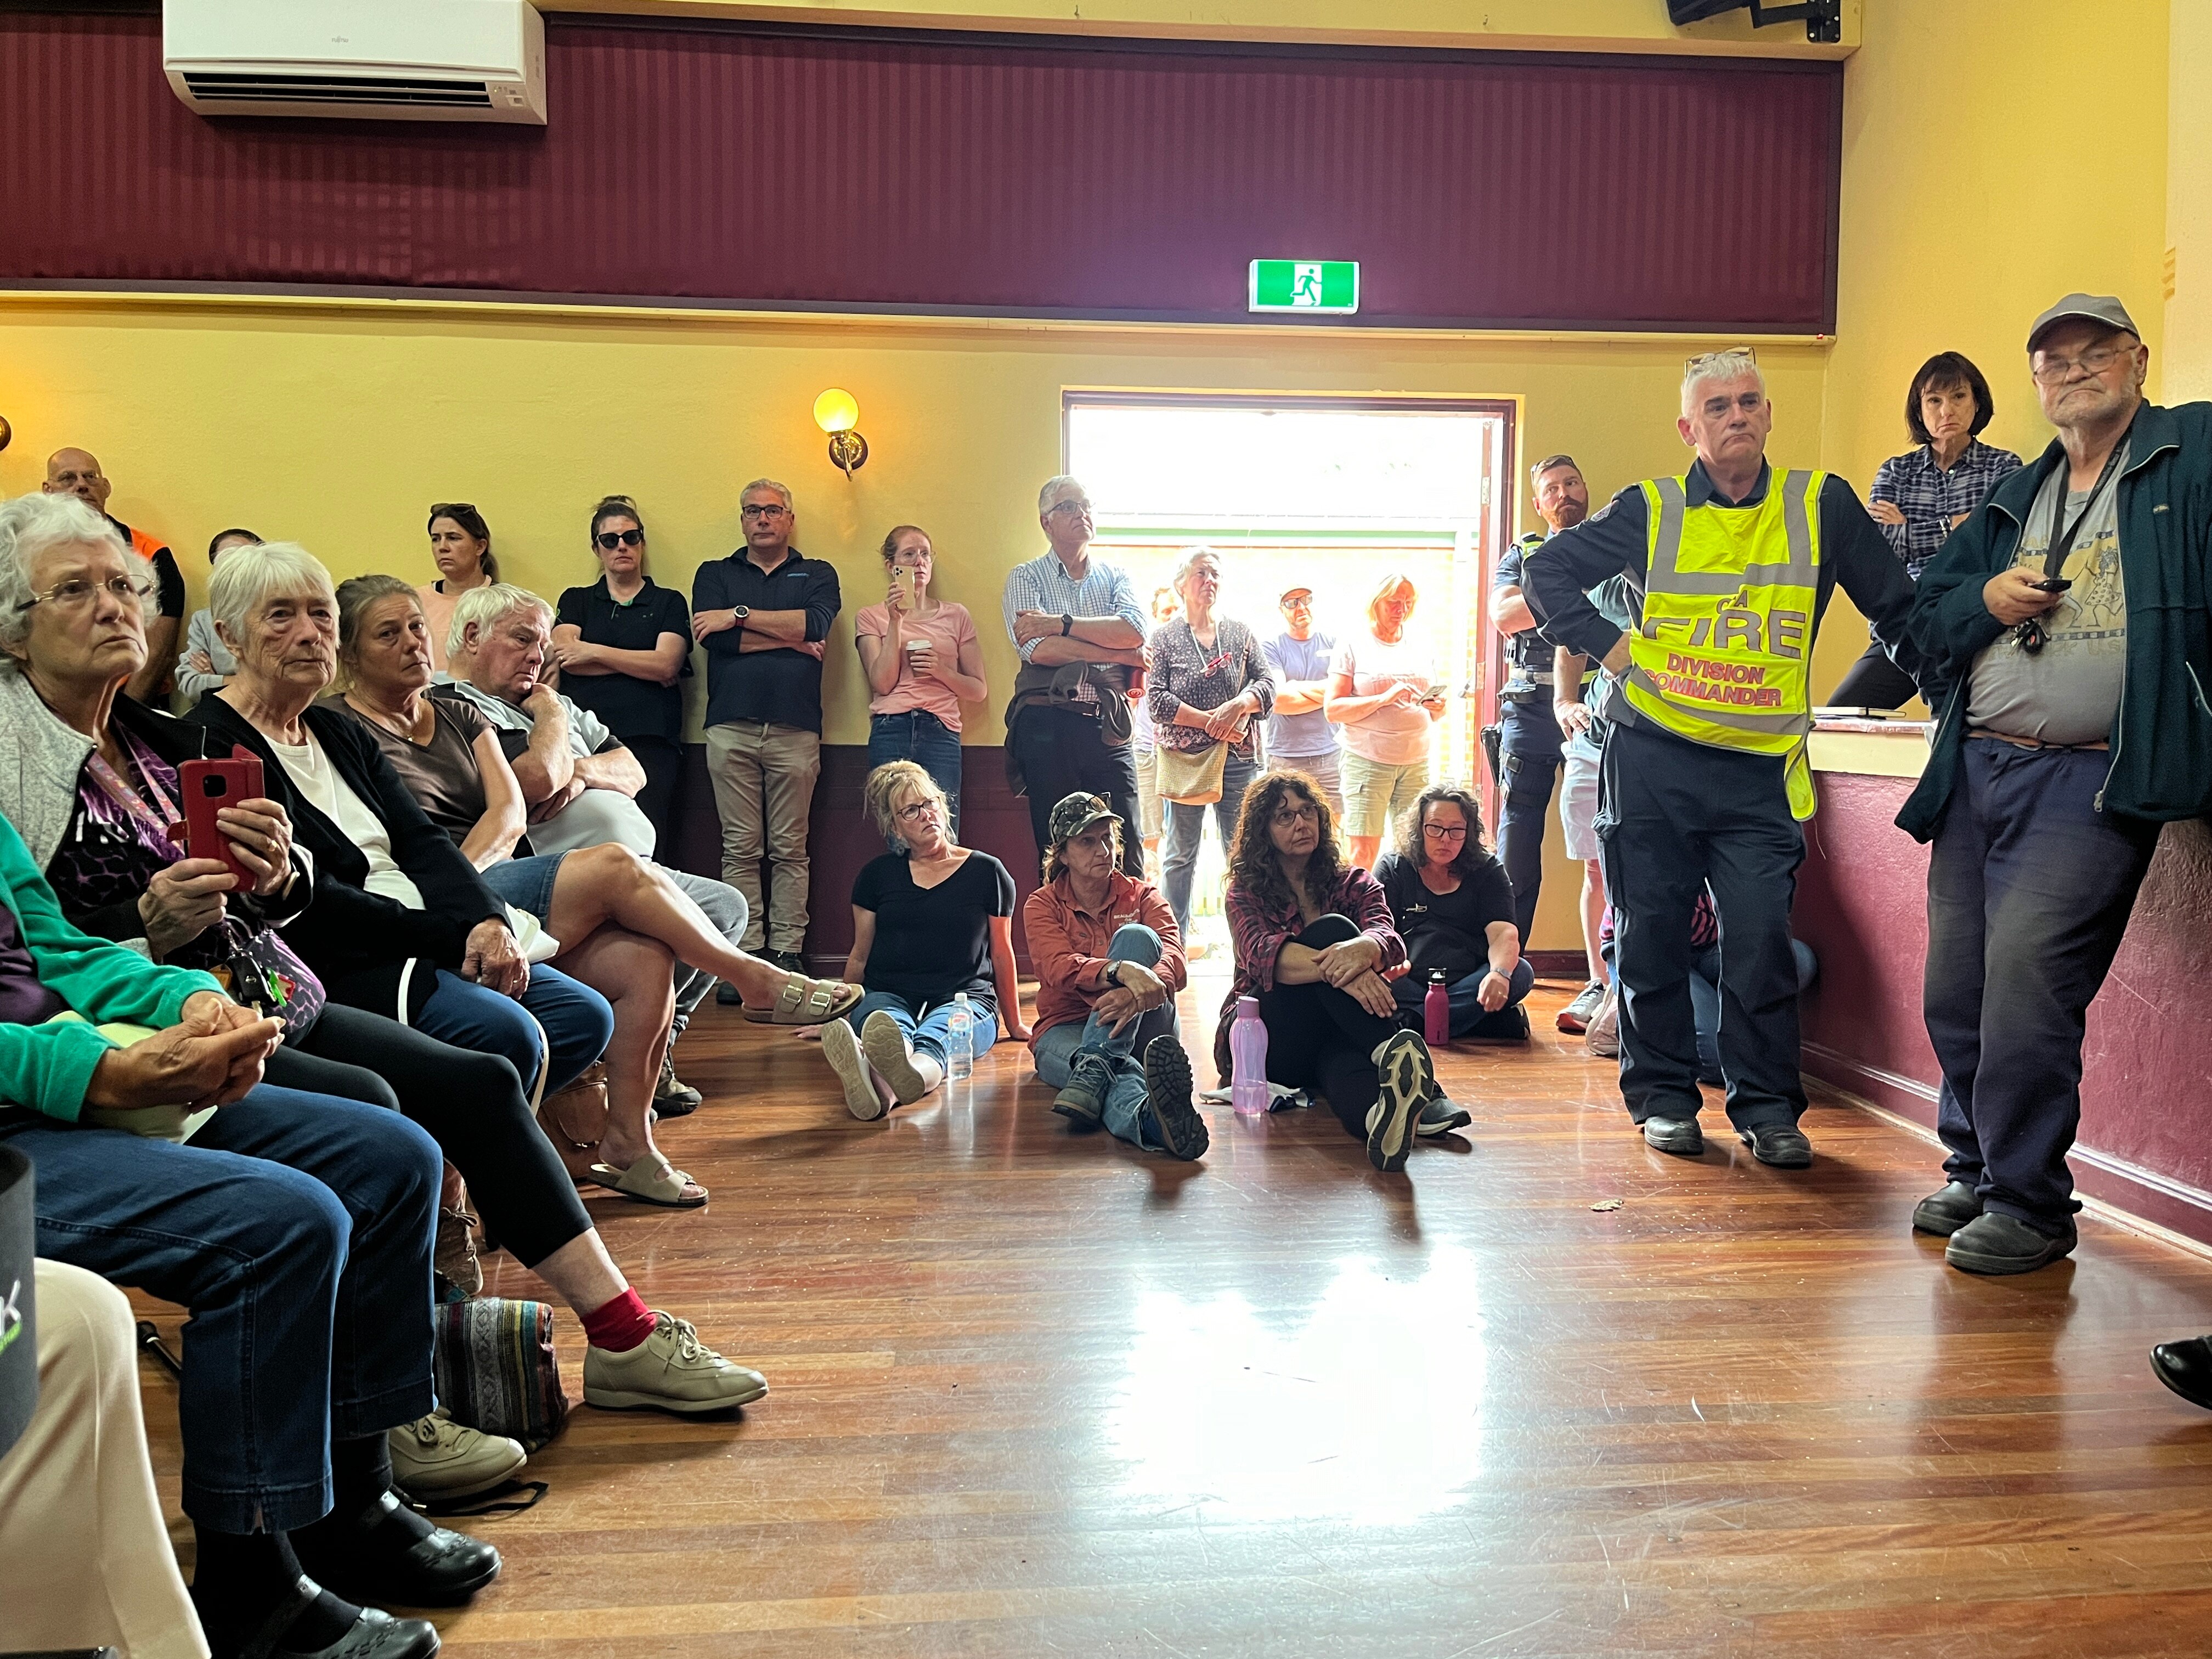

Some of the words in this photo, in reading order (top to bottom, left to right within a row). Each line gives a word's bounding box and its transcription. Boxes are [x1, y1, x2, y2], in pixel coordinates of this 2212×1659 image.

[1717, 590, 1748, 614] CA
[1642, 608, 1806, 659] FIRE
[1667, 653, 1765, 684] DIVISION
